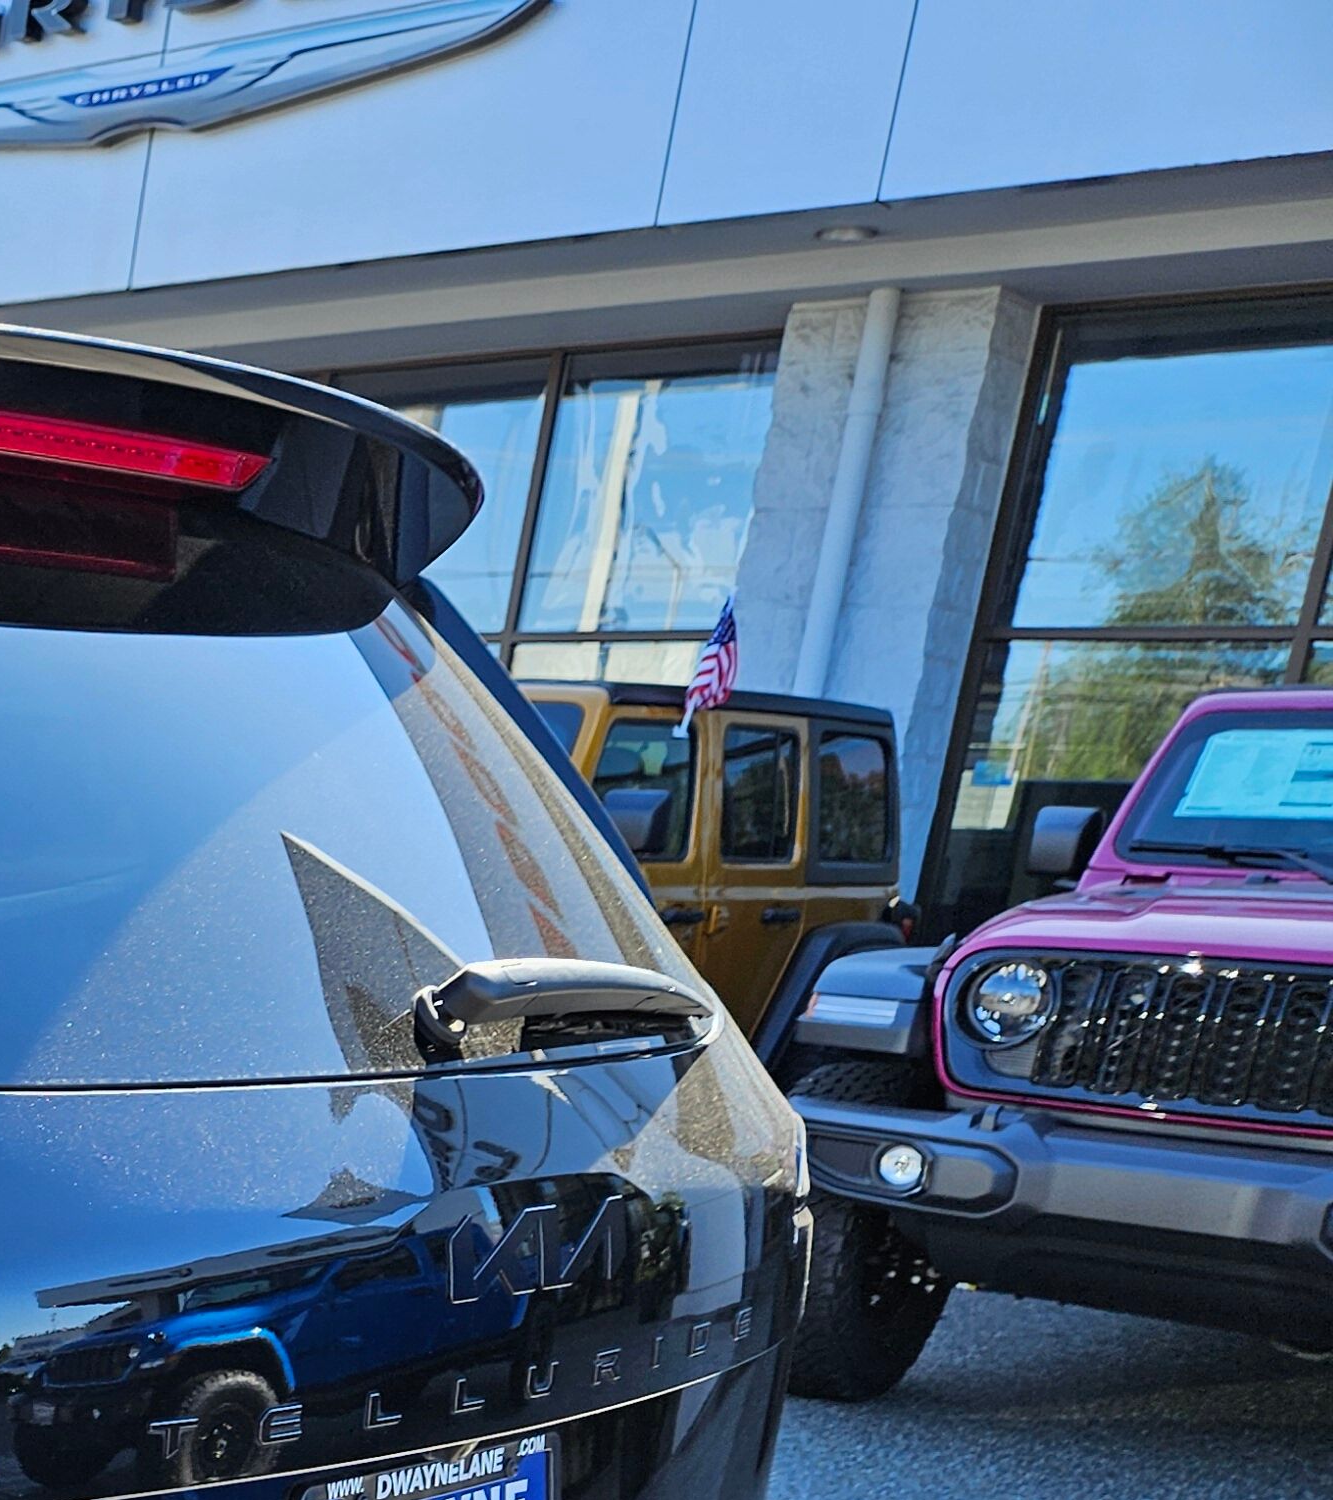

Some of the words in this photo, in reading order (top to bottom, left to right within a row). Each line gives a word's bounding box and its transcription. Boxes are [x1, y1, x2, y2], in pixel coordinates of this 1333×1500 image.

[74, 73, 210, 106] CHRYSLER
[148, 1306, 755, 1460] TELLURIDE
[376, 1447, 505, 1500] DWAYNELANE
